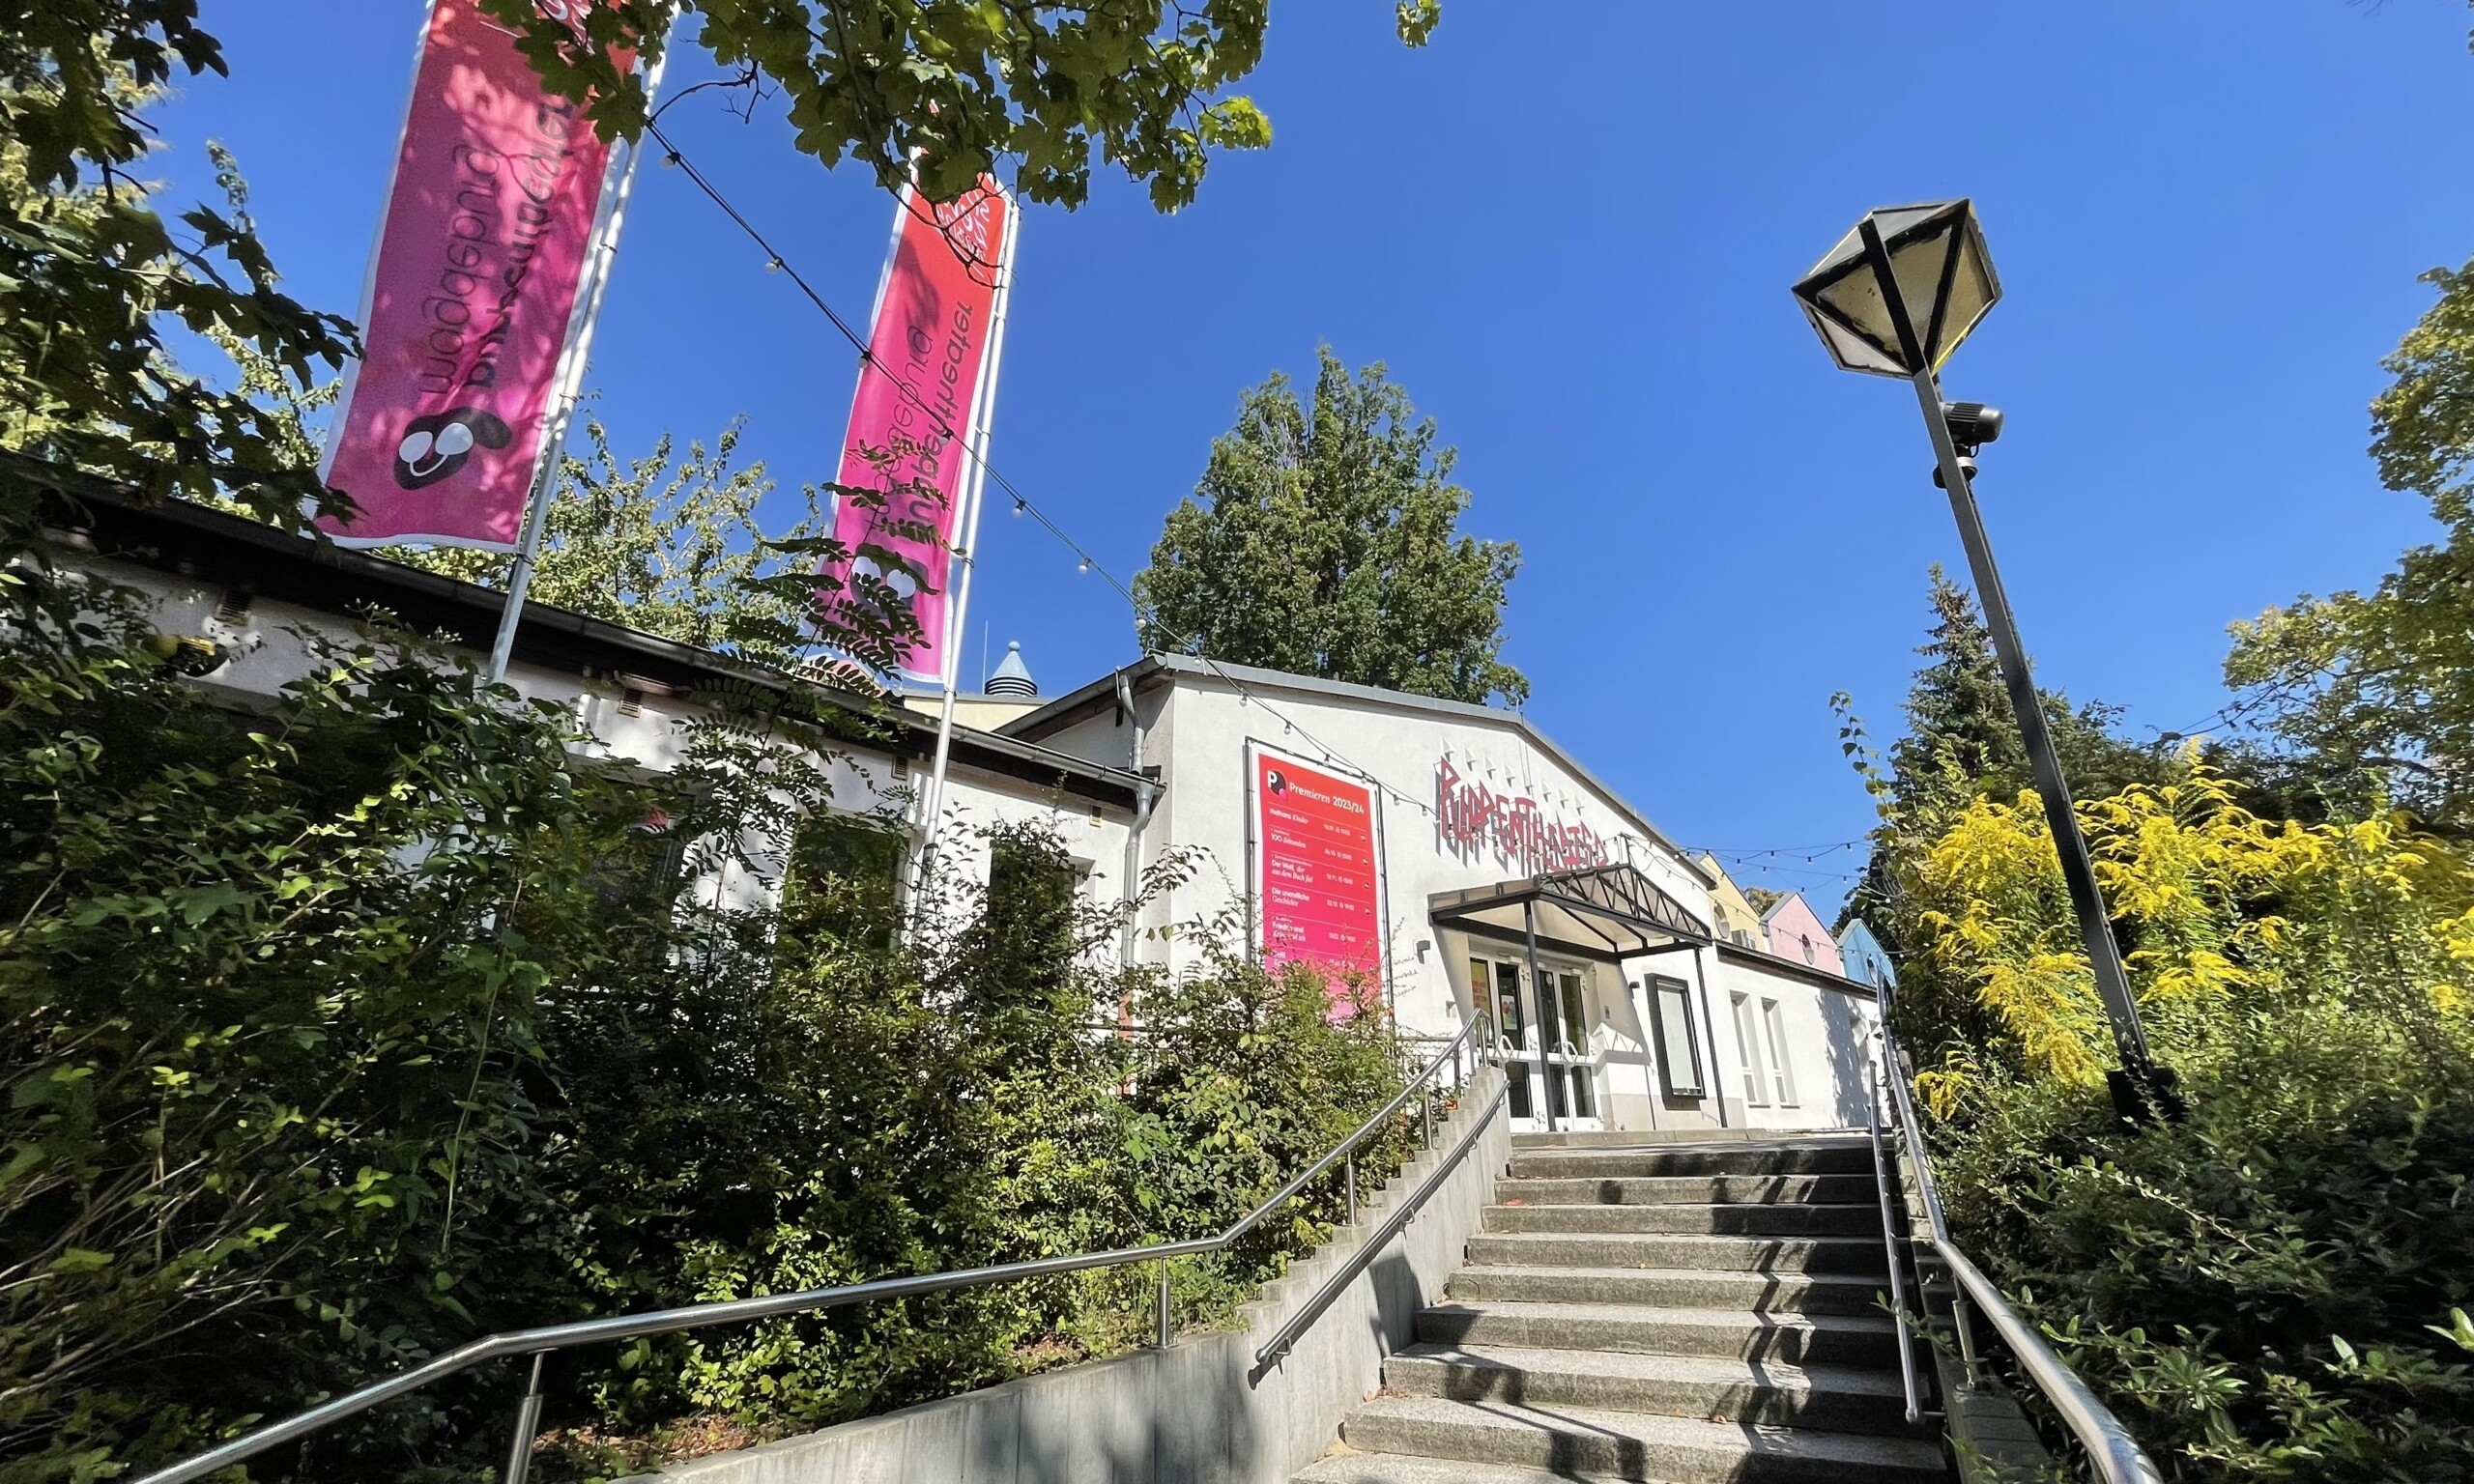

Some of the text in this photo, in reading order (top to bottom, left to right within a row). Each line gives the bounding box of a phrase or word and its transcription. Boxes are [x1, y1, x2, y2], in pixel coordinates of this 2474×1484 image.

[1289, 783, 1364, 813] Premieren 2023/24
[1272, 833, 1283, 842] 100
